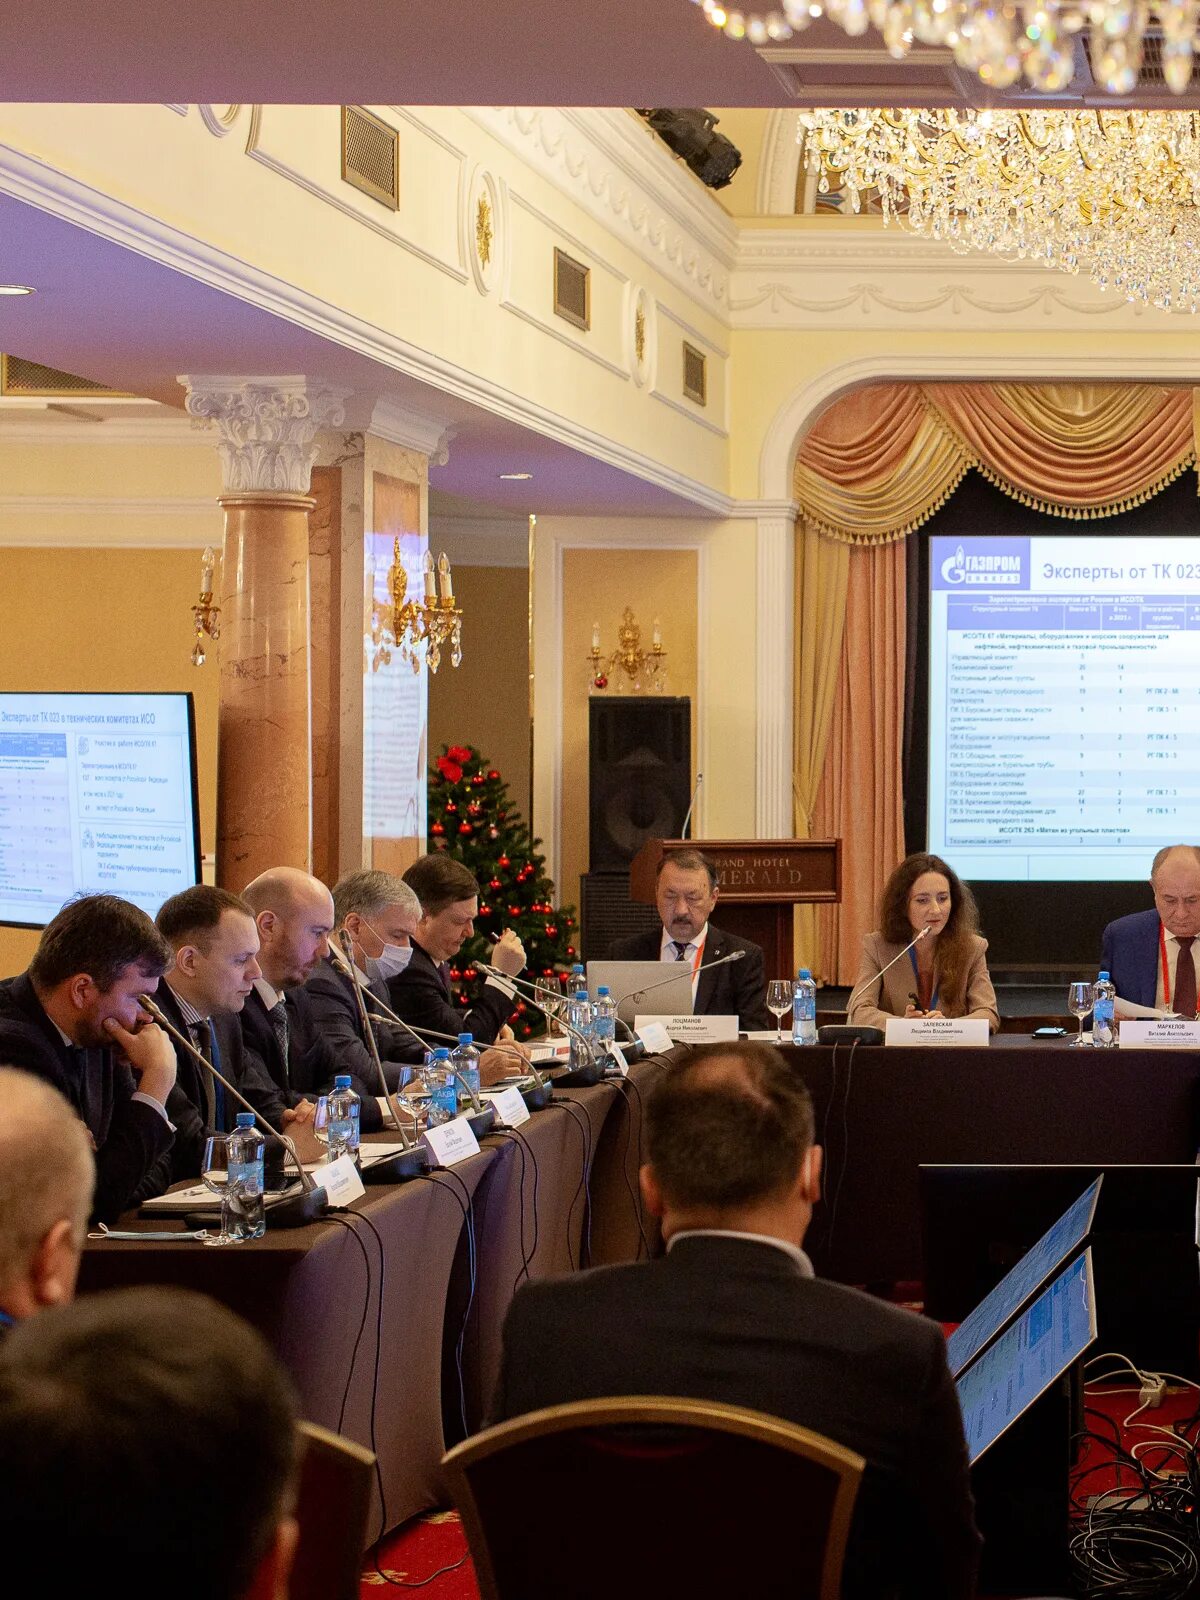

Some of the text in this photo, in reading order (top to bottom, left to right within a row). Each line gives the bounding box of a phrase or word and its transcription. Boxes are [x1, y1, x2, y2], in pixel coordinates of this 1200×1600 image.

[965, 556, 1021, 571] ГАЗПРОМ
[1043, 562, 1124, 582] Эксперты
[1129, 567, 1147, 579] от
[1152, 563, 1172, 579] ТК
[1, 711, 31, 725] Эксперты
[32, 714, 39, 723] от
[66, 714, 106, 724] технических
[106, 715, 140, 725] комитетах
[141, 712, 156, 725] ИСО
[715, 858, 790, 868] RAND HOTEL
[715, 870, 802, 885] MERALD
